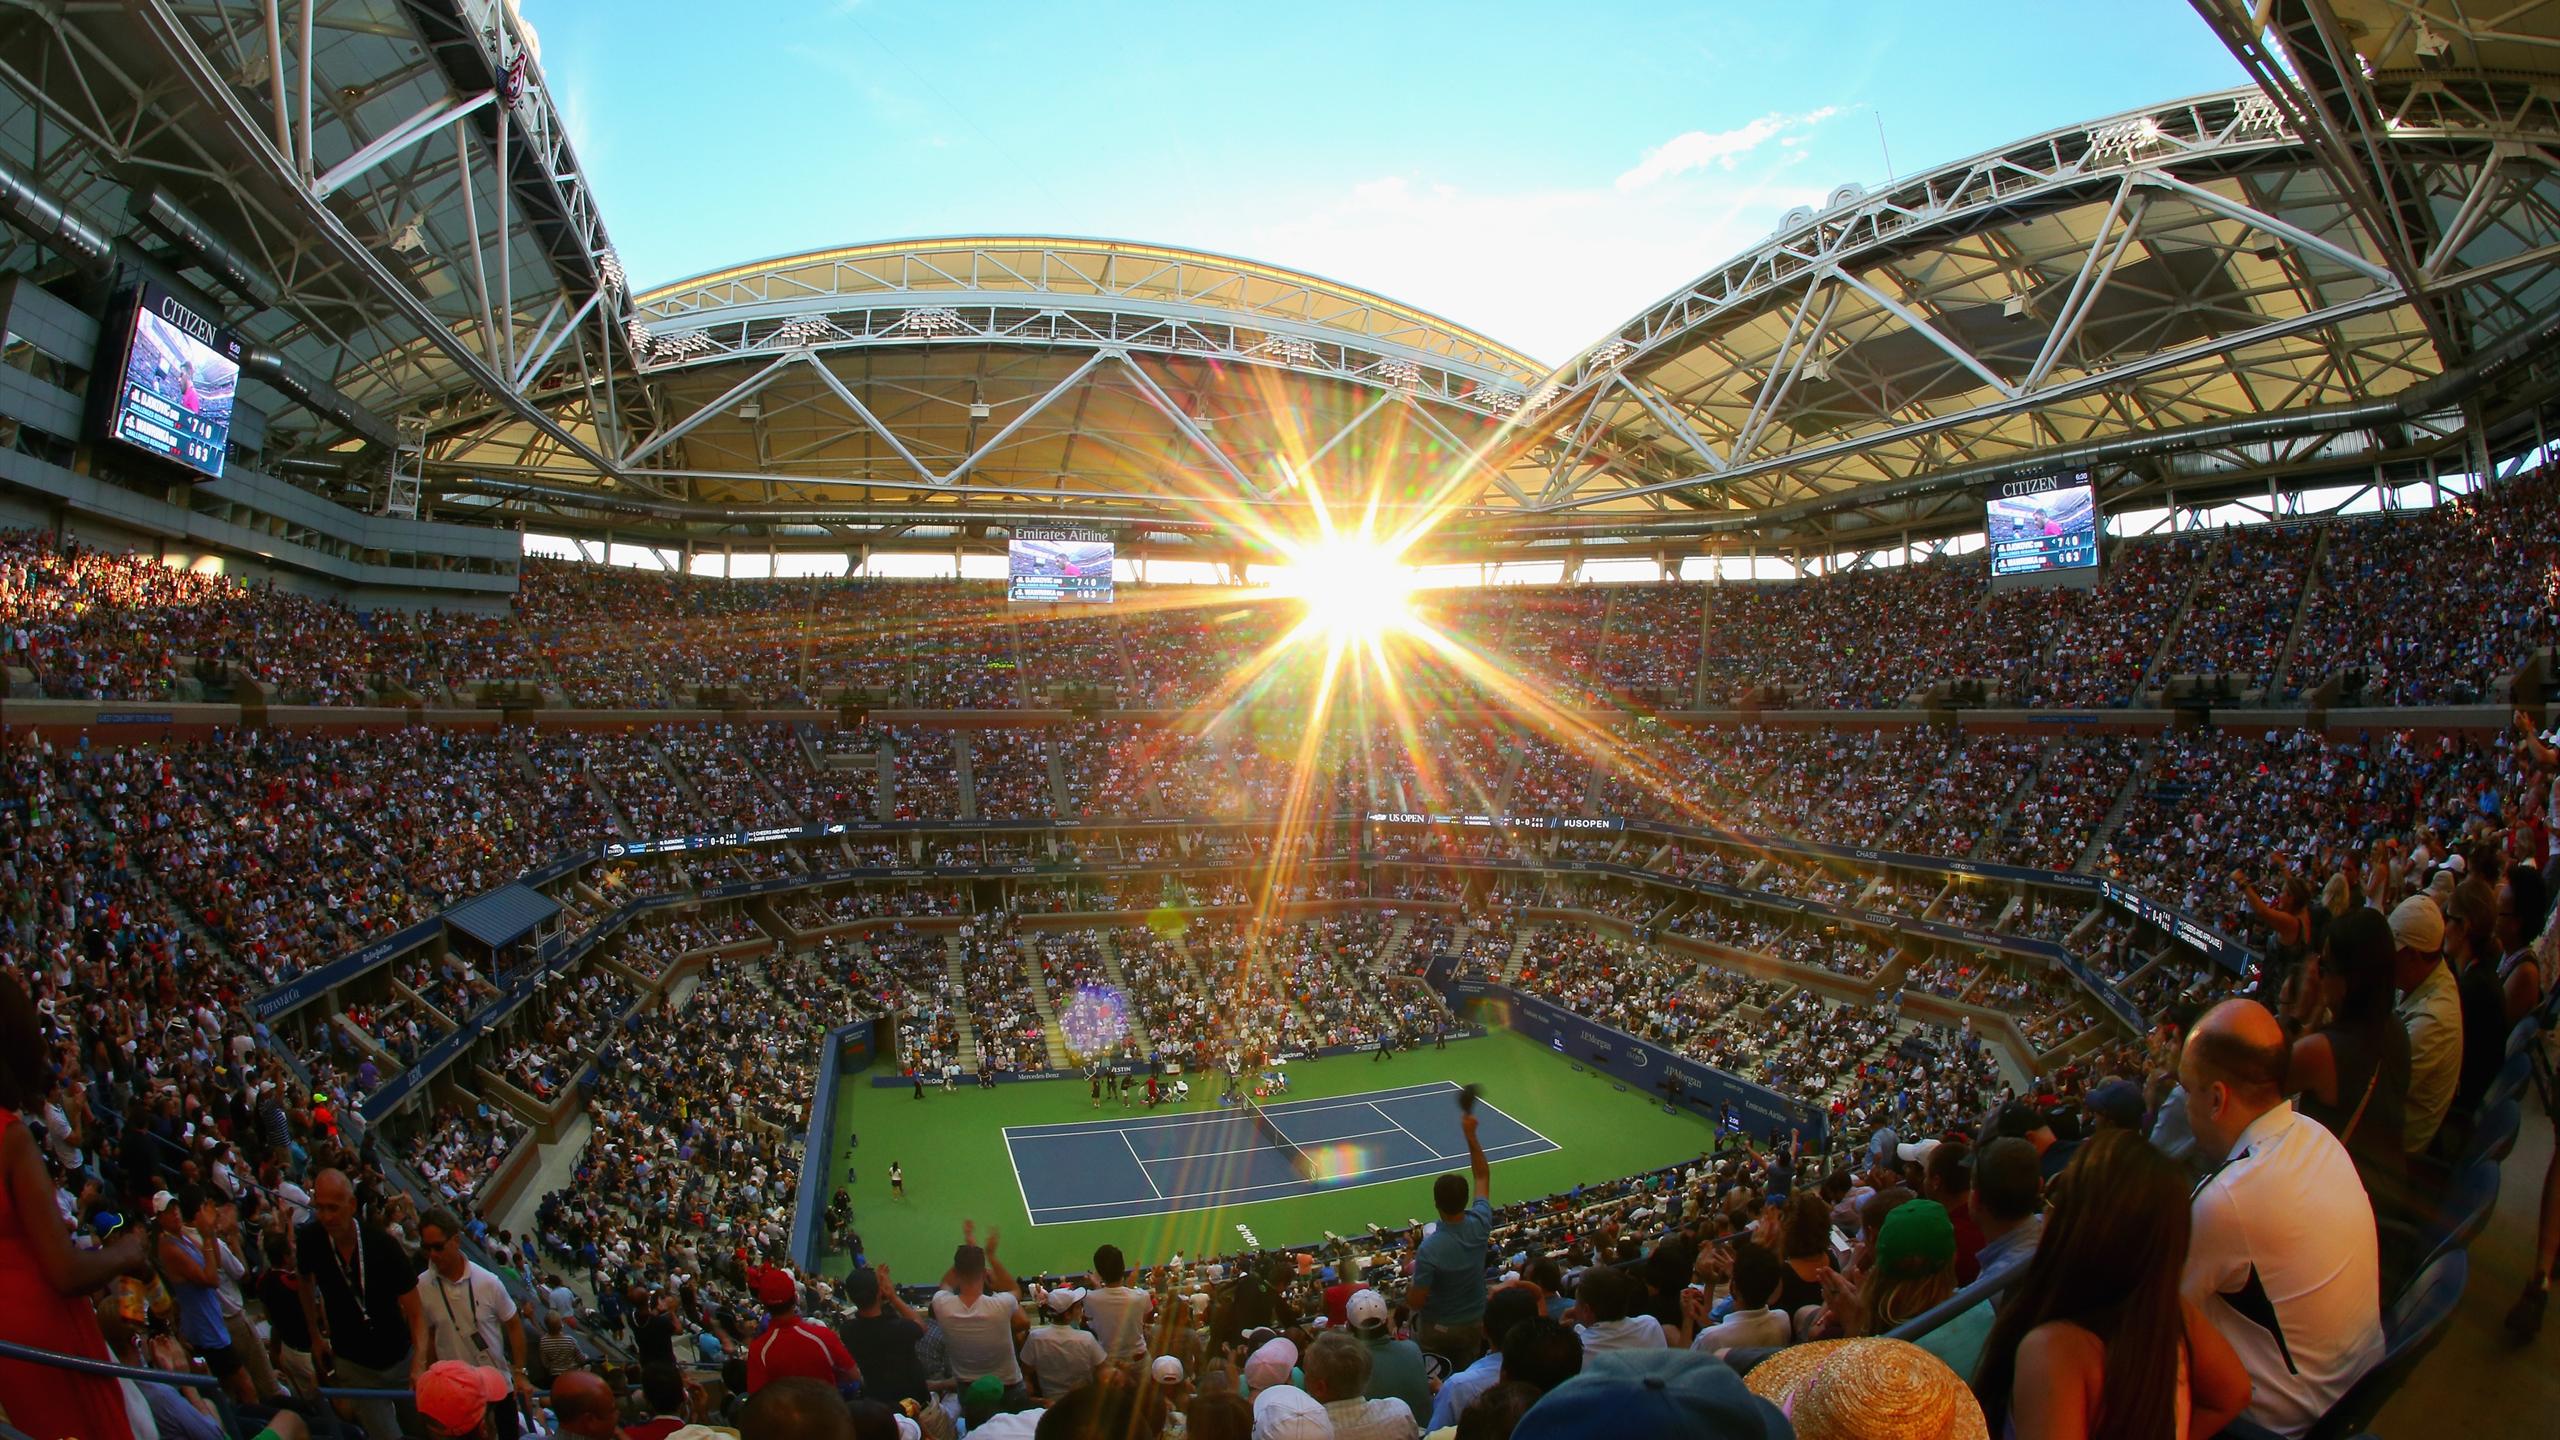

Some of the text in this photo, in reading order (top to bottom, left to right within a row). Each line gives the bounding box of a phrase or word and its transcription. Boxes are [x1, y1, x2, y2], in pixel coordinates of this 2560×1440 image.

[162, 296, 218, 346] CITIZEN
[193, 418, 212, 439] 7 4 0
[188, 442, 208, 462] 6 6 3
[2002, 476, 2058, 497] CITIZEN
[1016, 528, 1108, 541] Emirates Airline
[2058, 536, 2078, 548] 7 4 0
[2059, 551, 2080, 563] 6 6 3
[1077, 578, 1082, 586] 7
[1091, 578, 1096, 586] 0
[1077, 590, 1082, 598] 6
[1389, 814, 1424, 822] US OPEN
[1564, 819, 1610, 828] #USOPEN
[1856, 850, 1878, 859] CHASE
[1866, 914, 1891, 924] CITIZEN
